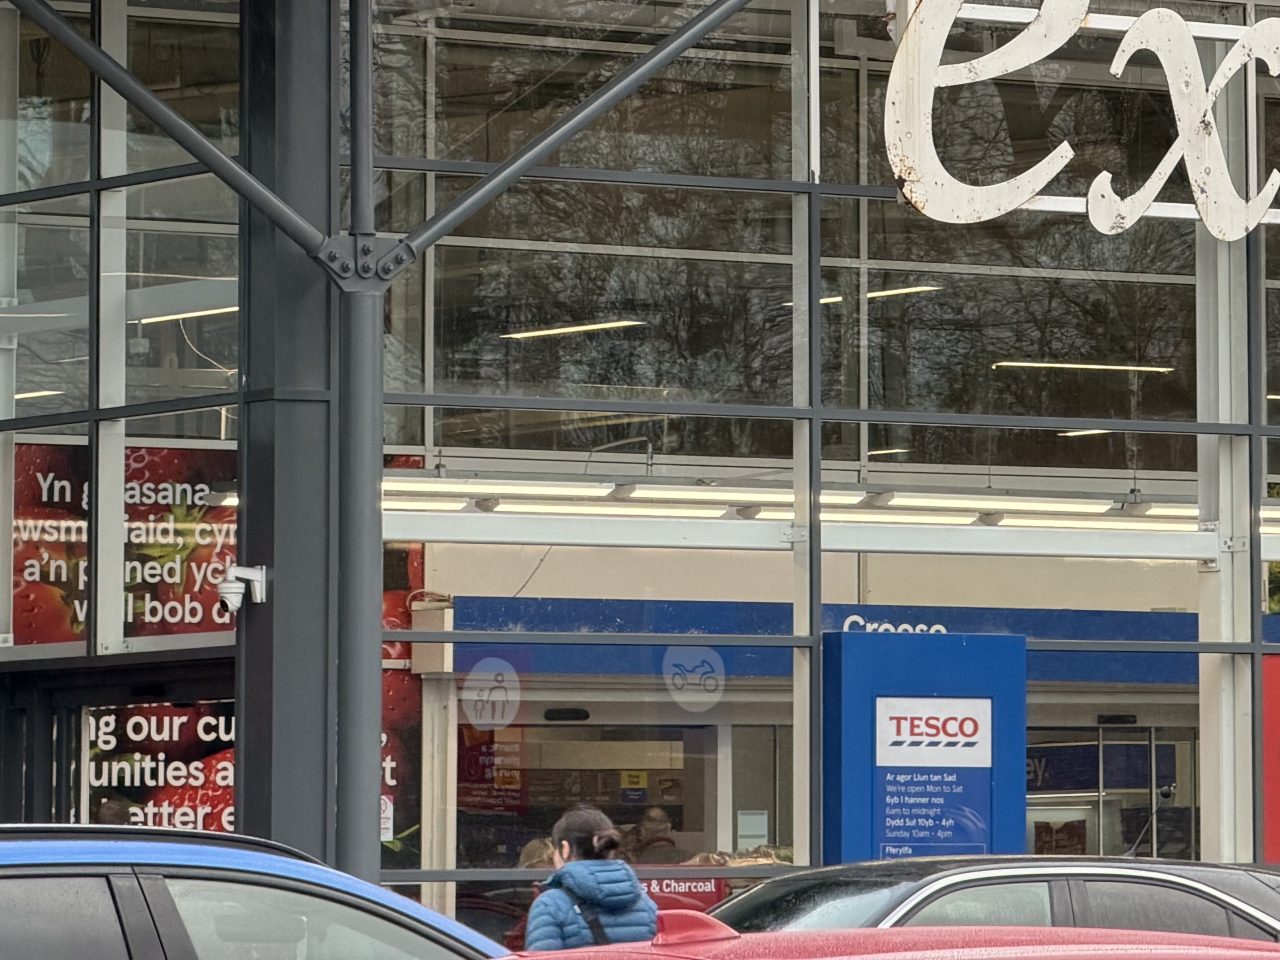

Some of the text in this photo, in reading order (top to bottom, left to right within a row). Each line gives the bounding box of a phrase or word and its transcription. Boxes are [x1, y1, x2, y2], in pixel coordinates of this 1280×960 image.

[36, 472, 71, 503] Yn
[145, 593, 203, 624] bob
[126, 715, 189, 742] our
[888, 716, 980, 738] TESCO
[926, 784, 942, 792] Mon
[911, 807, 941, 817] midnight
[885, 829, 910, 838] Sunday
[912, 830, 930, 838] 10am
[936, 830, 953, 839] 4pm
[650, 879, 660, 893] &
[662, 879, 716, 893] Charcoal
